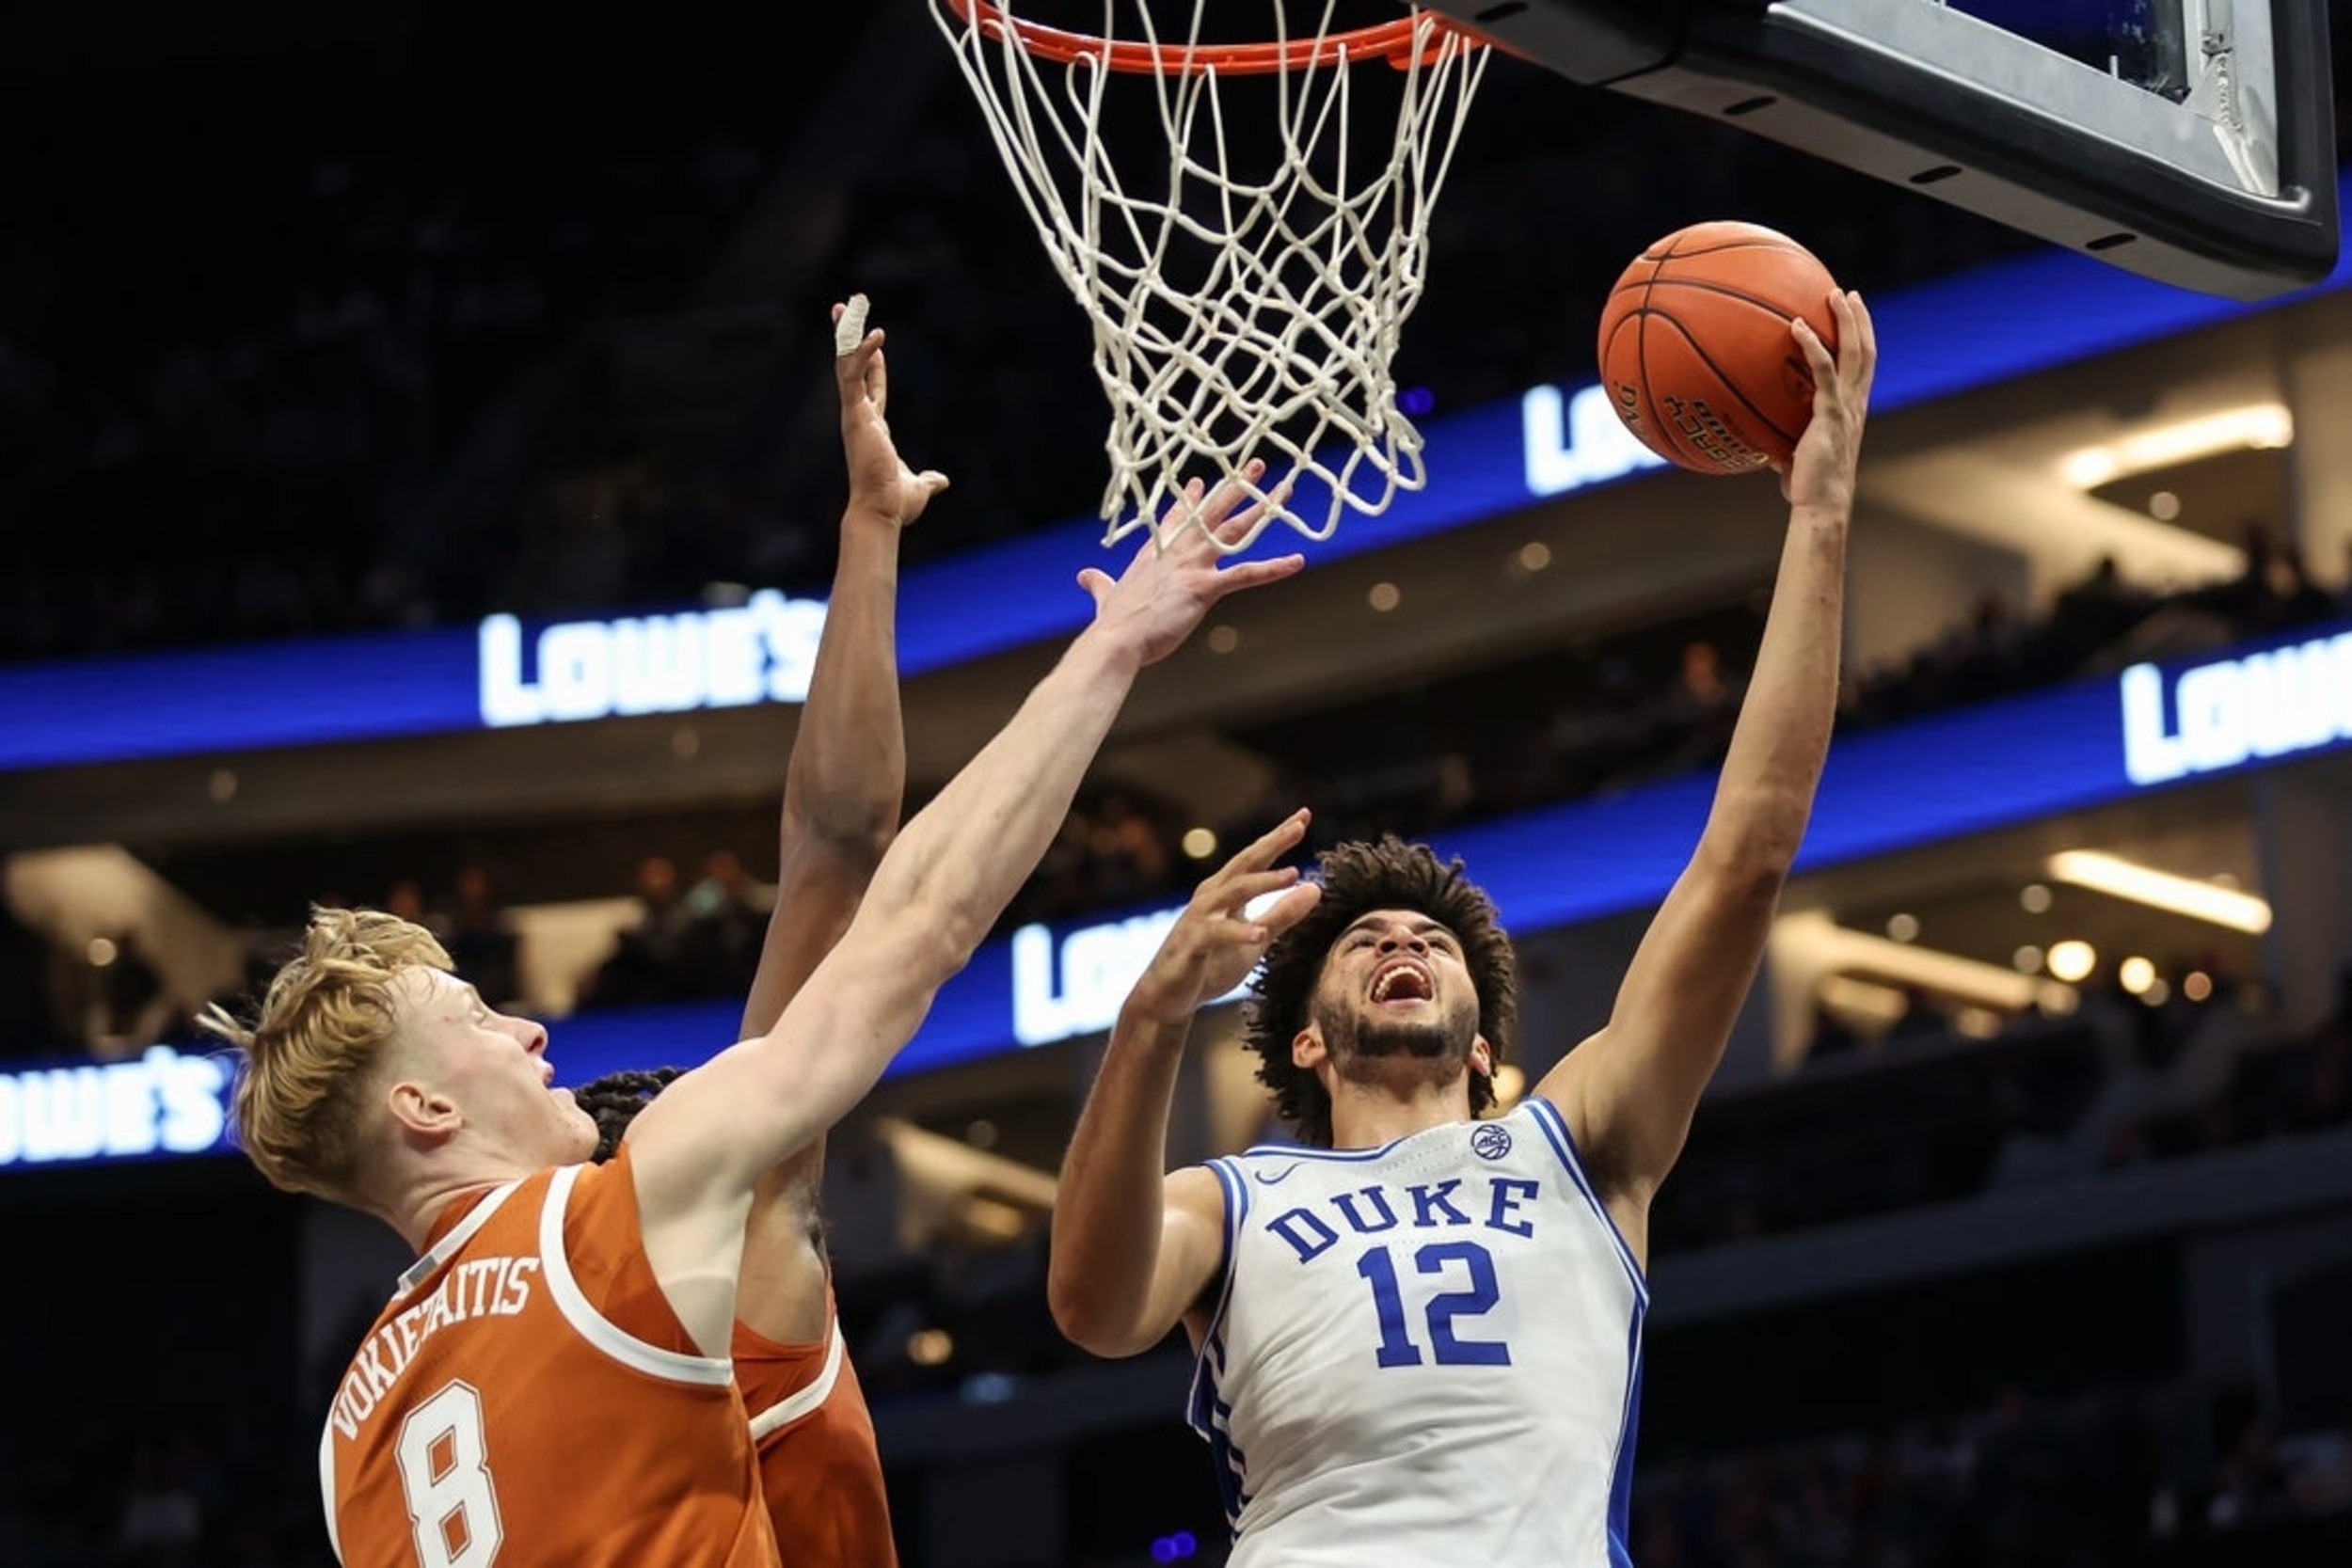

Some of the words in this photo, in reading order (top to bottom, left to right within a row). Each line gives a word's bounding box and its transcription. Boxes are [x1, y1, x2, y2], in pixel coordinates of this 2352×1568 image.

[2122, 631, 2352, 784] LOW
[1266, 1179, 1540, 1265] DUKE
[1356, 1240, 1512, 1368] 12
[393, 1377, 503, 1568] 8
